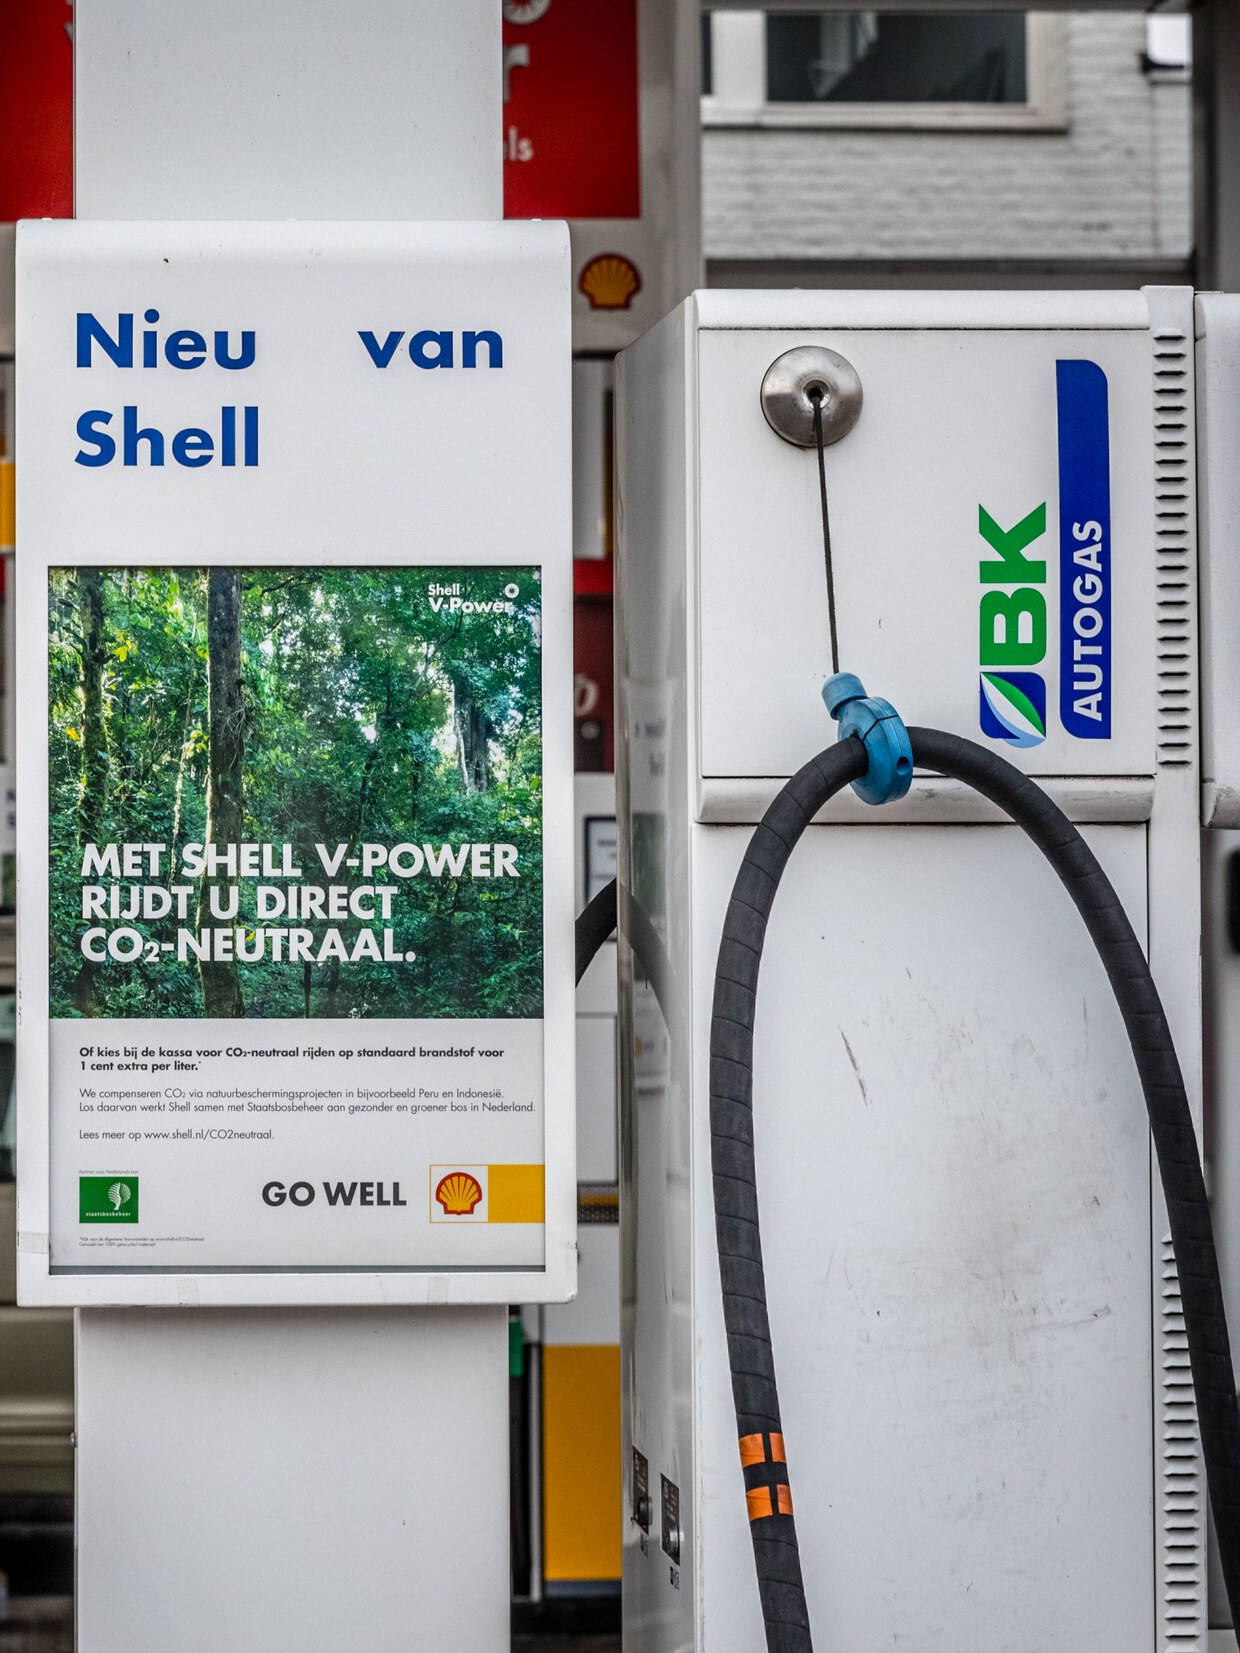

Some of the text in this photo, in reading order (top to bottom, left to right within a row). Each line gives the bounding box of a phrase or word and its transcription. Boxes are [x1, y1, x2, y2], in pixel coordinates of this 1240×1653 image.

[76, 308, 504, 371] Nieu van
[74, 405, 259, 468] Shell
[427, 583, 461, 596] Shell
[979, 501, 1047, 666] BK
[428, 597, 513, 613] V-Power
[1071, 520, 1104, 722] AUTOGAS
[80, 842, 521, 878] MET SHELL V-POWER
[81, 885, 399, 920] RIJDT U DIRECT
[79, 1046, 95, 1058] Of
[97, 1046, 121, 1058] kies
[123, 1046, 138, 1060] bij
[140, 1046, 156, 1058] de
[158, 1046, 193, 1058] kassa
[195, 1049, 223, 1058] voor
[302, 1046, 336, 1060] rijden
[338, 1049, 354, 1060] op
[356, 1046, 416, 1058] standaard
[419, 1046, 475, 1058] brandstof
[477, 1049, 505, 1058] voor
[80, 1061, 87, 1071] 1
[90, 1061, 114, 1071] cent
[117, 1061, 148, 1071] extra
[151, 1063, 171, 1074] per
[78, 1088, 97, 1099] We
[98, 1091, 162, 1101] compenseren
[188, 1088, 204, 1099] via
[206, 1087, 343, 1102] natuurbeschermingsprojecten
[345, 1088, 354, 1098] in
[356, 1087, 416, 1101] bijvoorbeeld
[418, 1087, 440, 1099] Peru
[441, 1091, 454, 1099] en
[456, 1087, 504, 1099] Indonesië.
[79, 1101, 536, 1115] Los daarvan werkt Shell samen met Staatsbosbeheer aan gezonder en groener bos in Nederland.
[79, 1128, 275, 1142] Lees meer op www.shell.nl/CO2neutraal.
[261, 1181, 407, 1208] GO WELL
